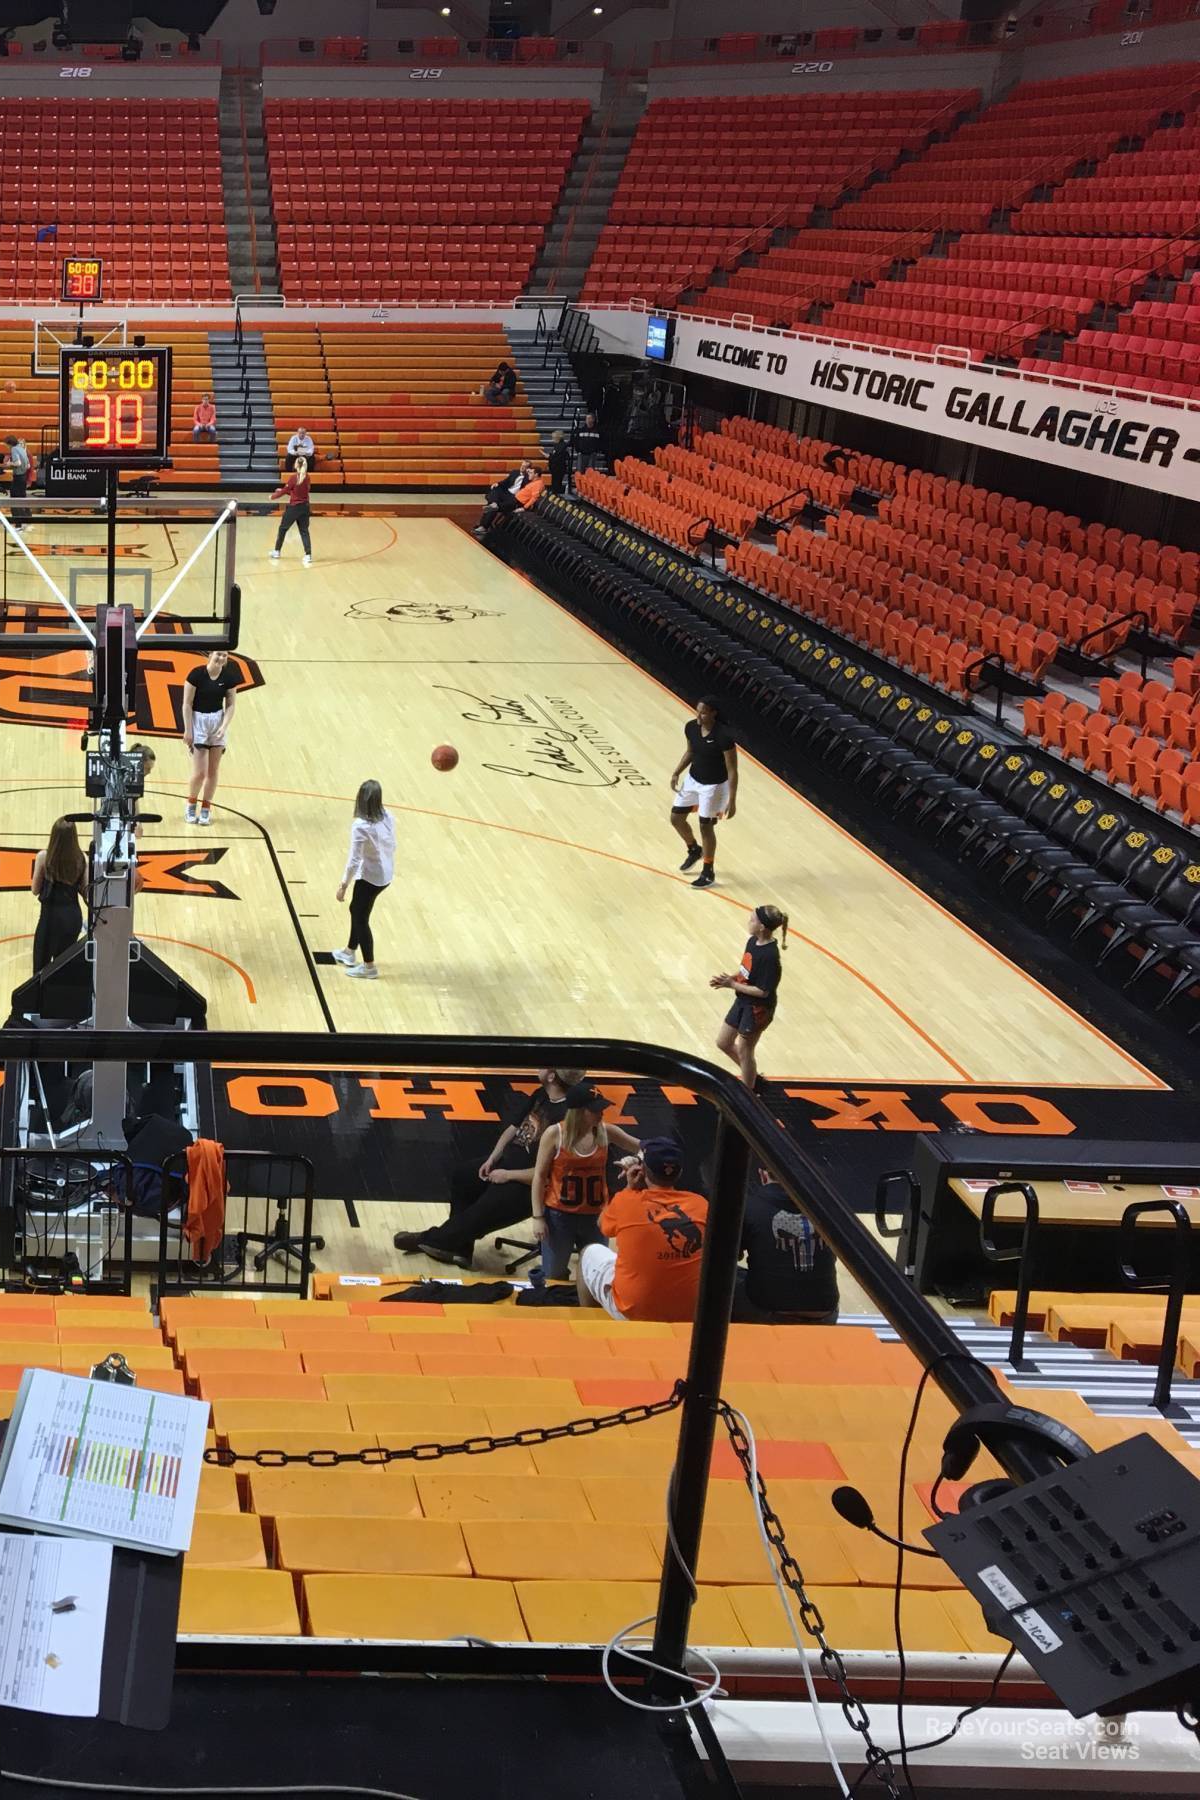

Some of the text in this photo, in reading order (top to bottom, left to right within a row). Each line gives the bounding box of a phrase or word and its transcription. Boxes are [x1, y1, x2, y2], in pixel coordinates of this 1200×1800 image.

[1120, 31, 1145, 47] 201
[59, 66, 93, 78] 218
[410, 68, 443, 78] 219
[791, 61, 833, 73] 220
[68, 262, 99, 275] 60:00
[71, 275, 94, 295] 30
[72, 360, 154, 389] 60:00
[697, 338, 764, 370] WELCOME
[766, 352, 788, 376] TO
[810, 359, 935, 412] HISTORIC
[1094, 400, 1120, 416] 102
[85, 393, 144, 447] 30
[544, 695, 652, 787] EDDIE SUTTON COURT
